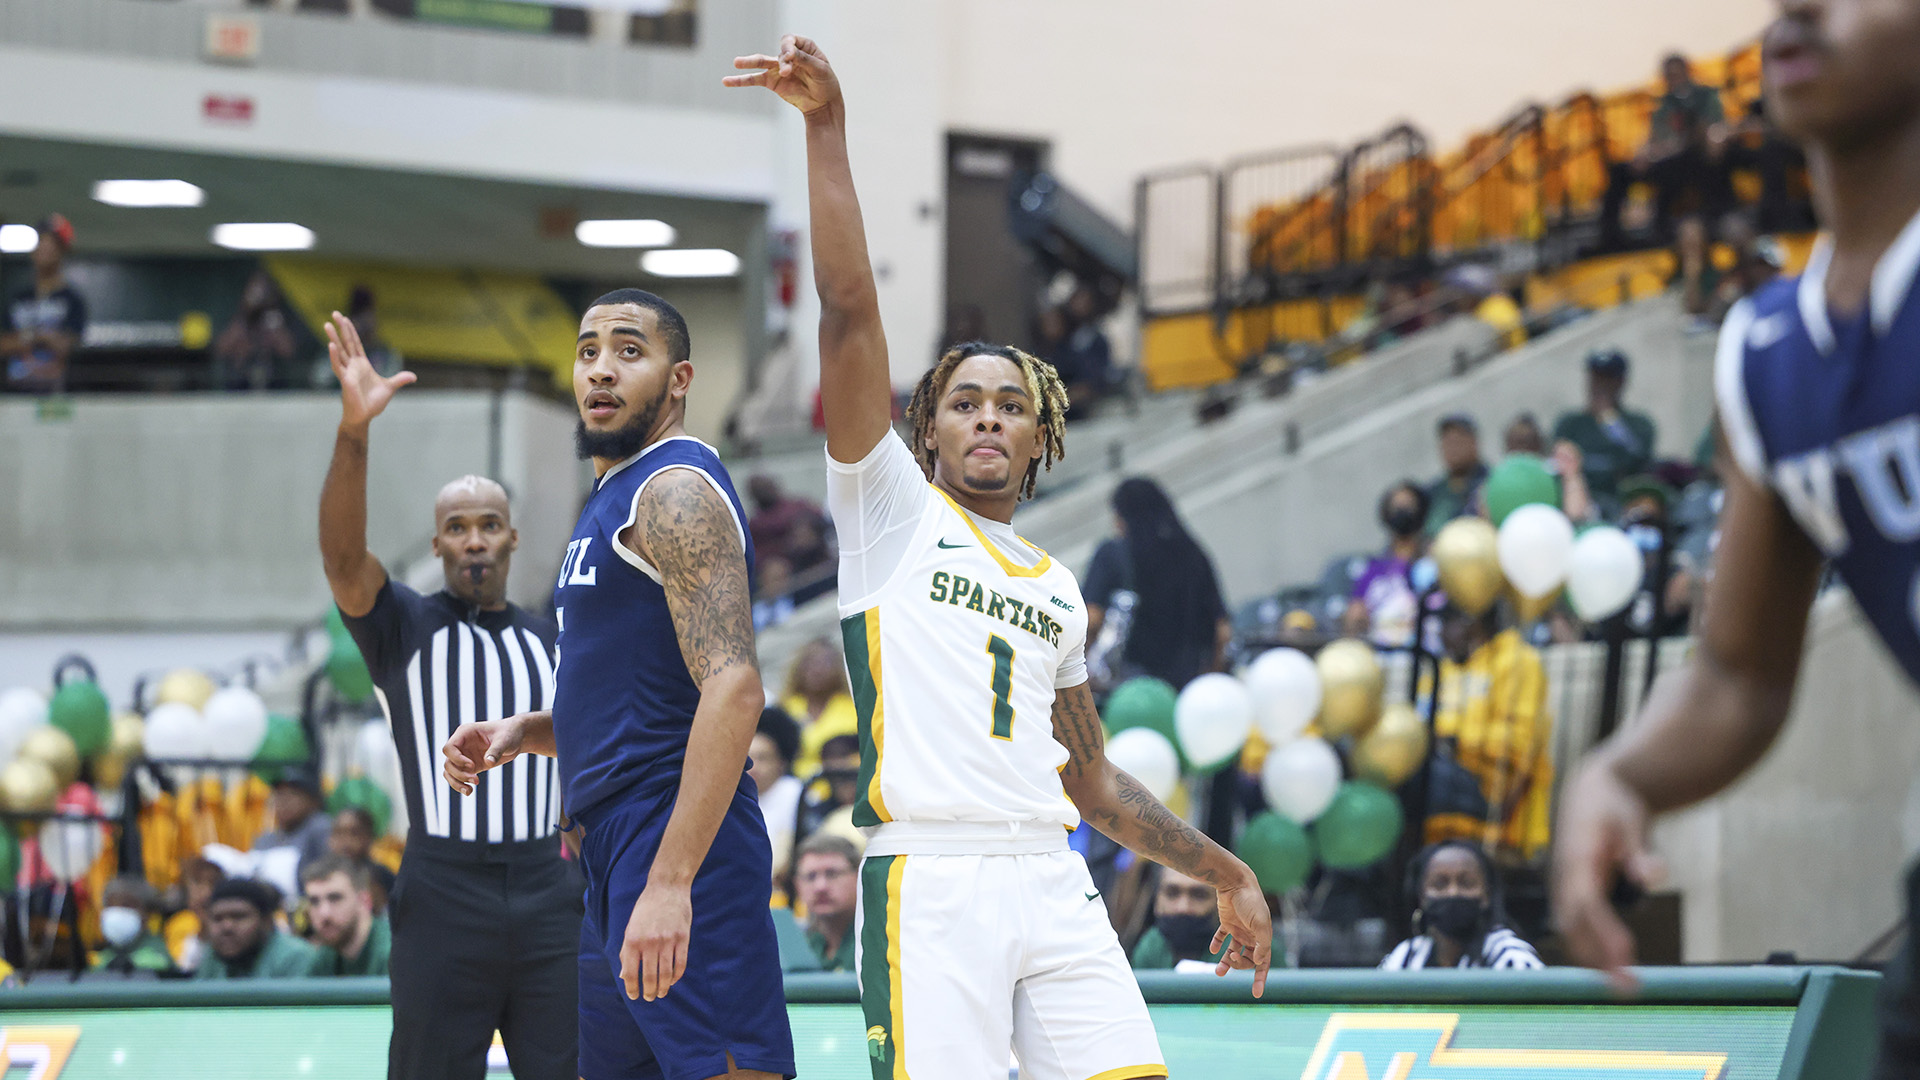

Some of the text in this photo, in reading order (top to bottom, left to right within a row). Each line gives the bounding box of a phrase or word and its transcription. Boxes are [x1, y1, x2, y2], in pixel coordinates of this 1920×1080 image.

[930, 571, 1063, 650] SPARTANS
[1050, 595, 1075, 613] MEAC
[985, 632, 1016, 742] 1
